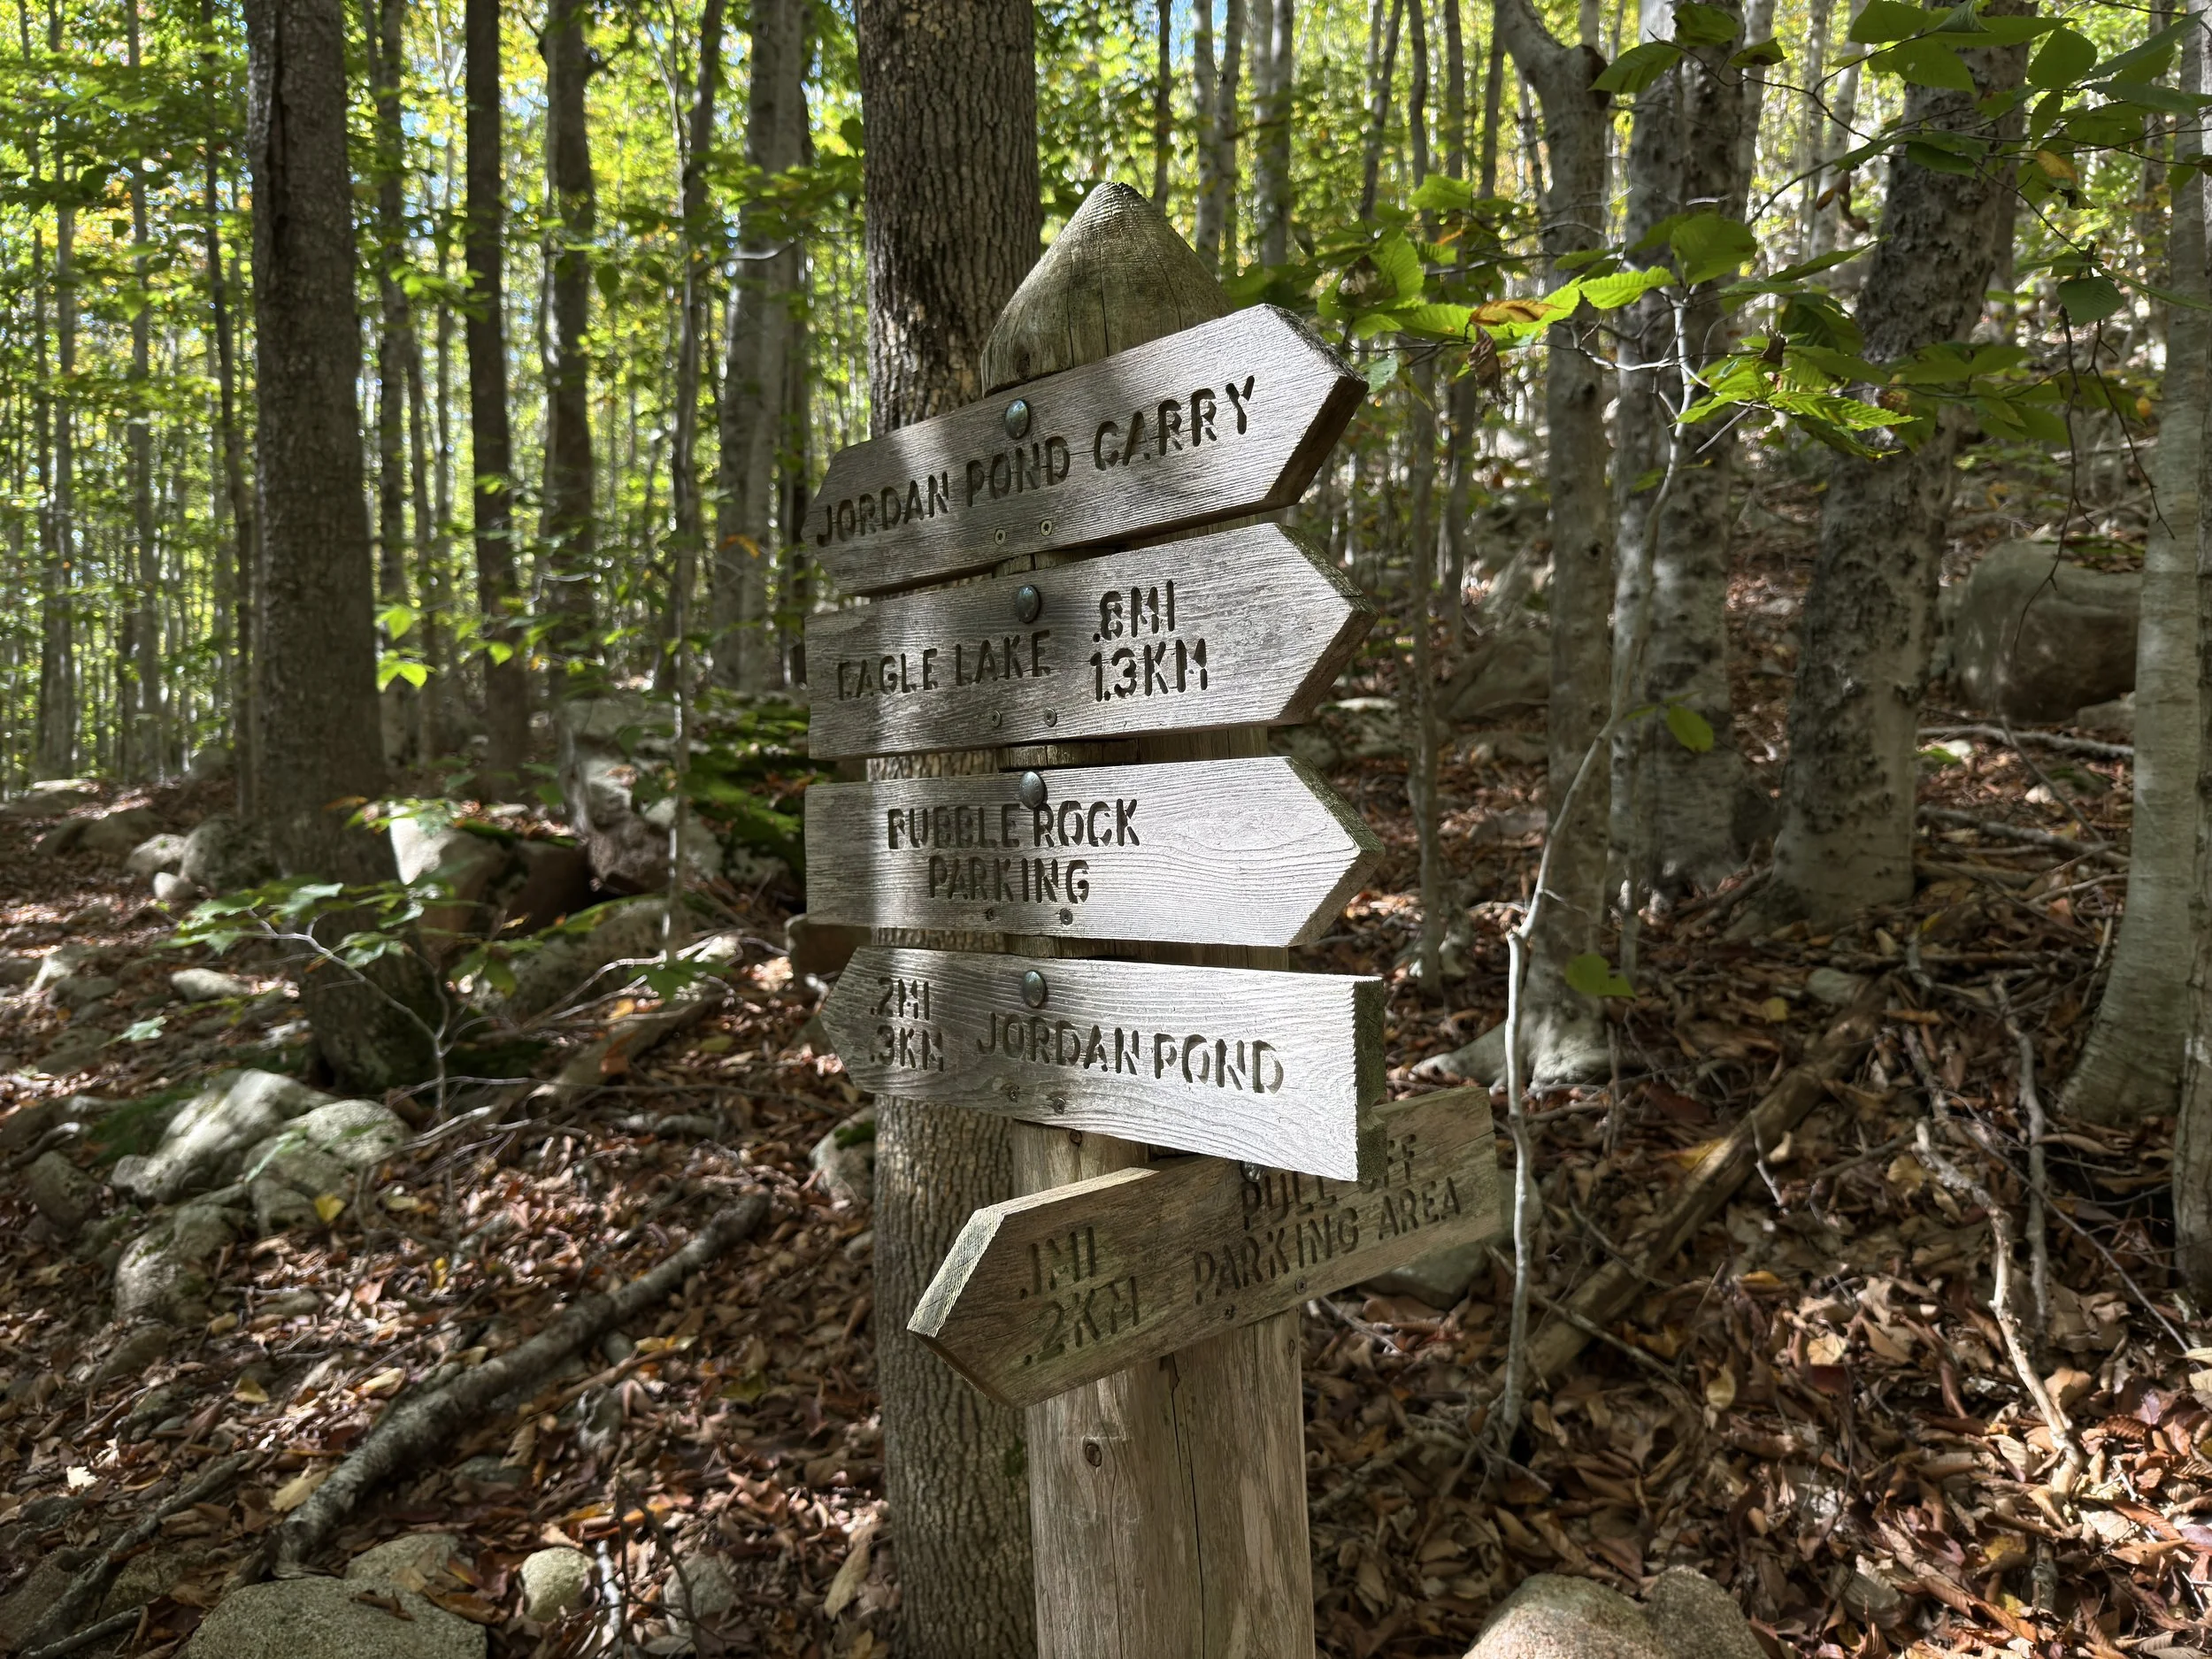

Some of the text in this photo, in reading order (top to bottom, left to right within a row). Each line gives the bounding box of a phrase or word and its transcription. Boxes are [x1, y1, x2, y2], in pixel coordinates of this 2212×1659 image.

[816, 375, 1256, 548] JORDAN POND CARRY
[838, 629, 1051, 701] EAGLE LAKE
[1089, 638, 1209, 703] 1.3KM
[1033, 798, 1141, 847] ROCK
[928, 855, 1090, 904] PARKING
[870, 977, 930, 1021] .2MI
[870, 1025, 945, 1072] .3KM
[976, 1012, 1286, 1095] JORDAN POND
[1194, 1176, 1462, 1306] PARKING AREA
[1022, 1276, 1141, 1367] .2KM
